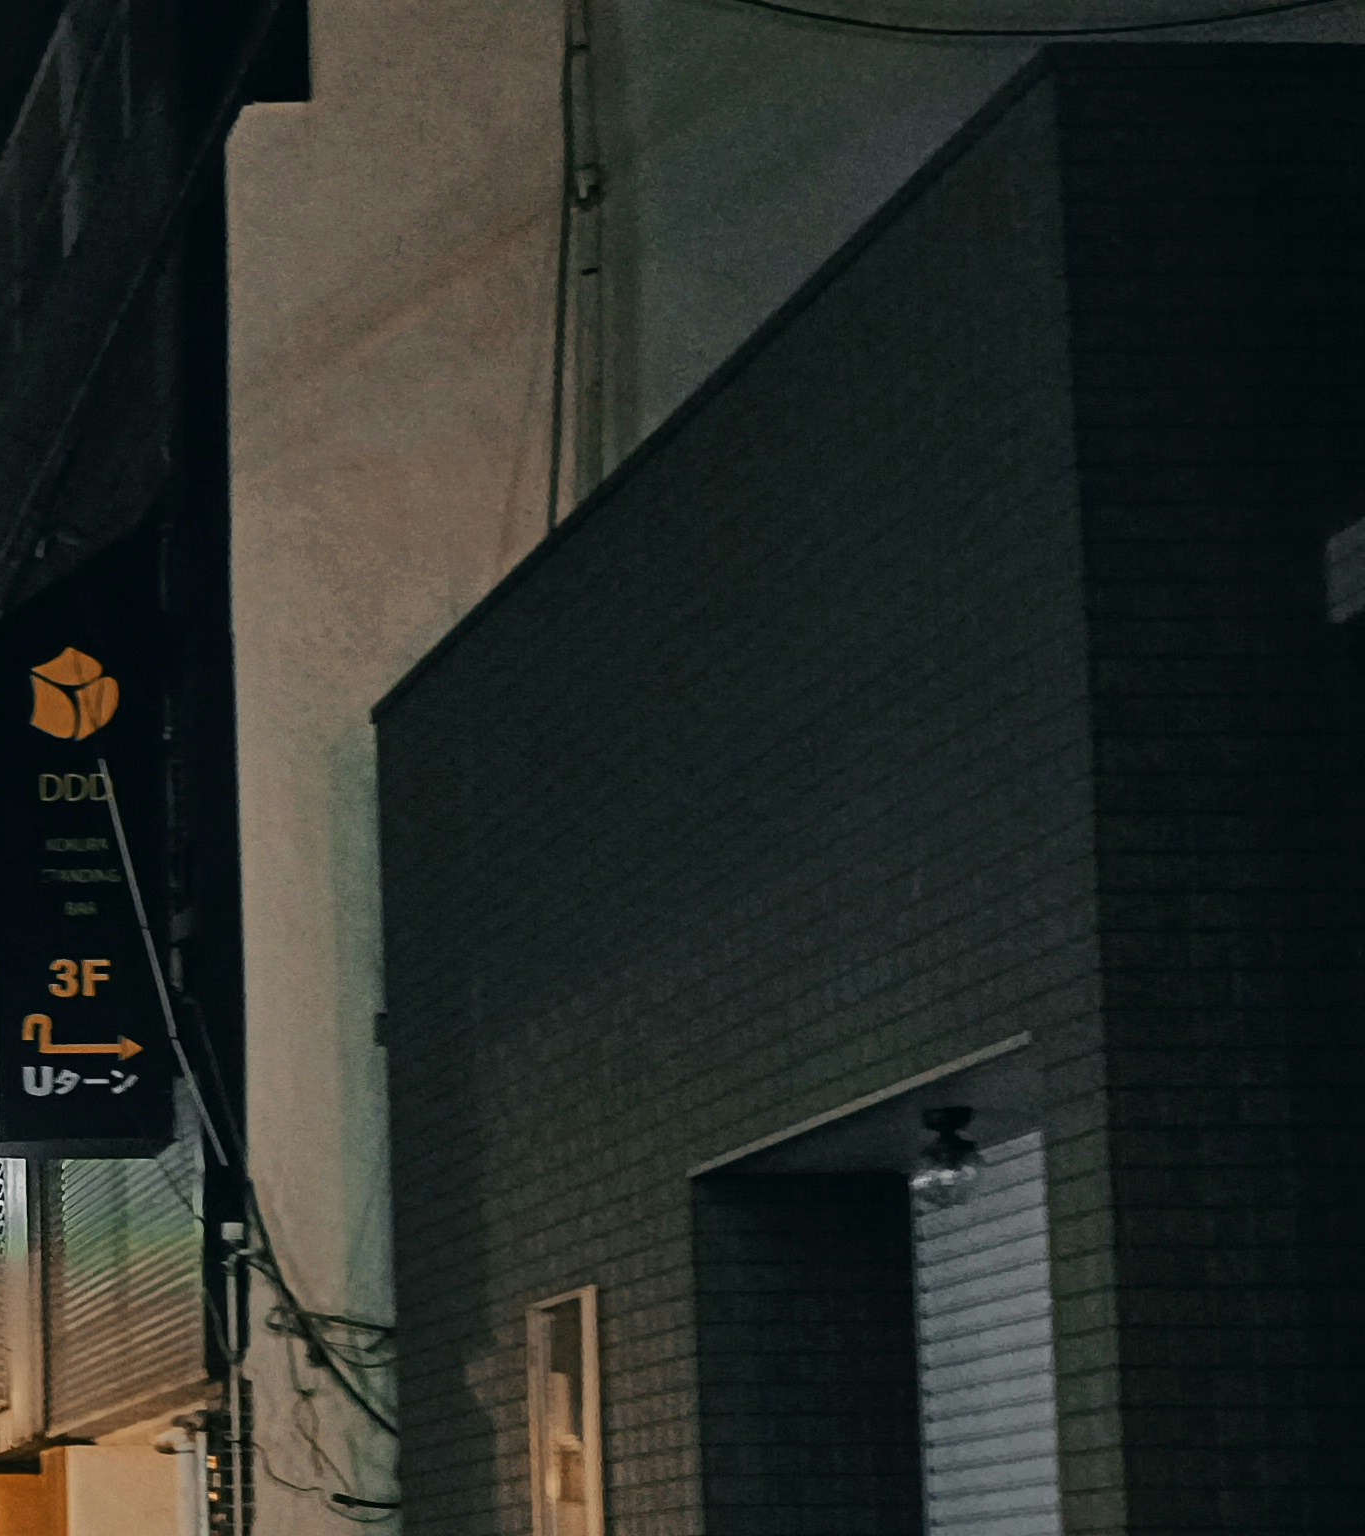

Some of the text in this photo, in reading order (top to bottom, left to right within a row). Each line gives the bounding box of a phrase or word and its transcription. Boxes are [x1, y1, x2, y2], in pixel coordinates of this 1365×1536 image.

[38, 773, 114, 801] DDD
[48, 959, 112, 997] 3F
[22, 1066, 139, 1097] Uターン
